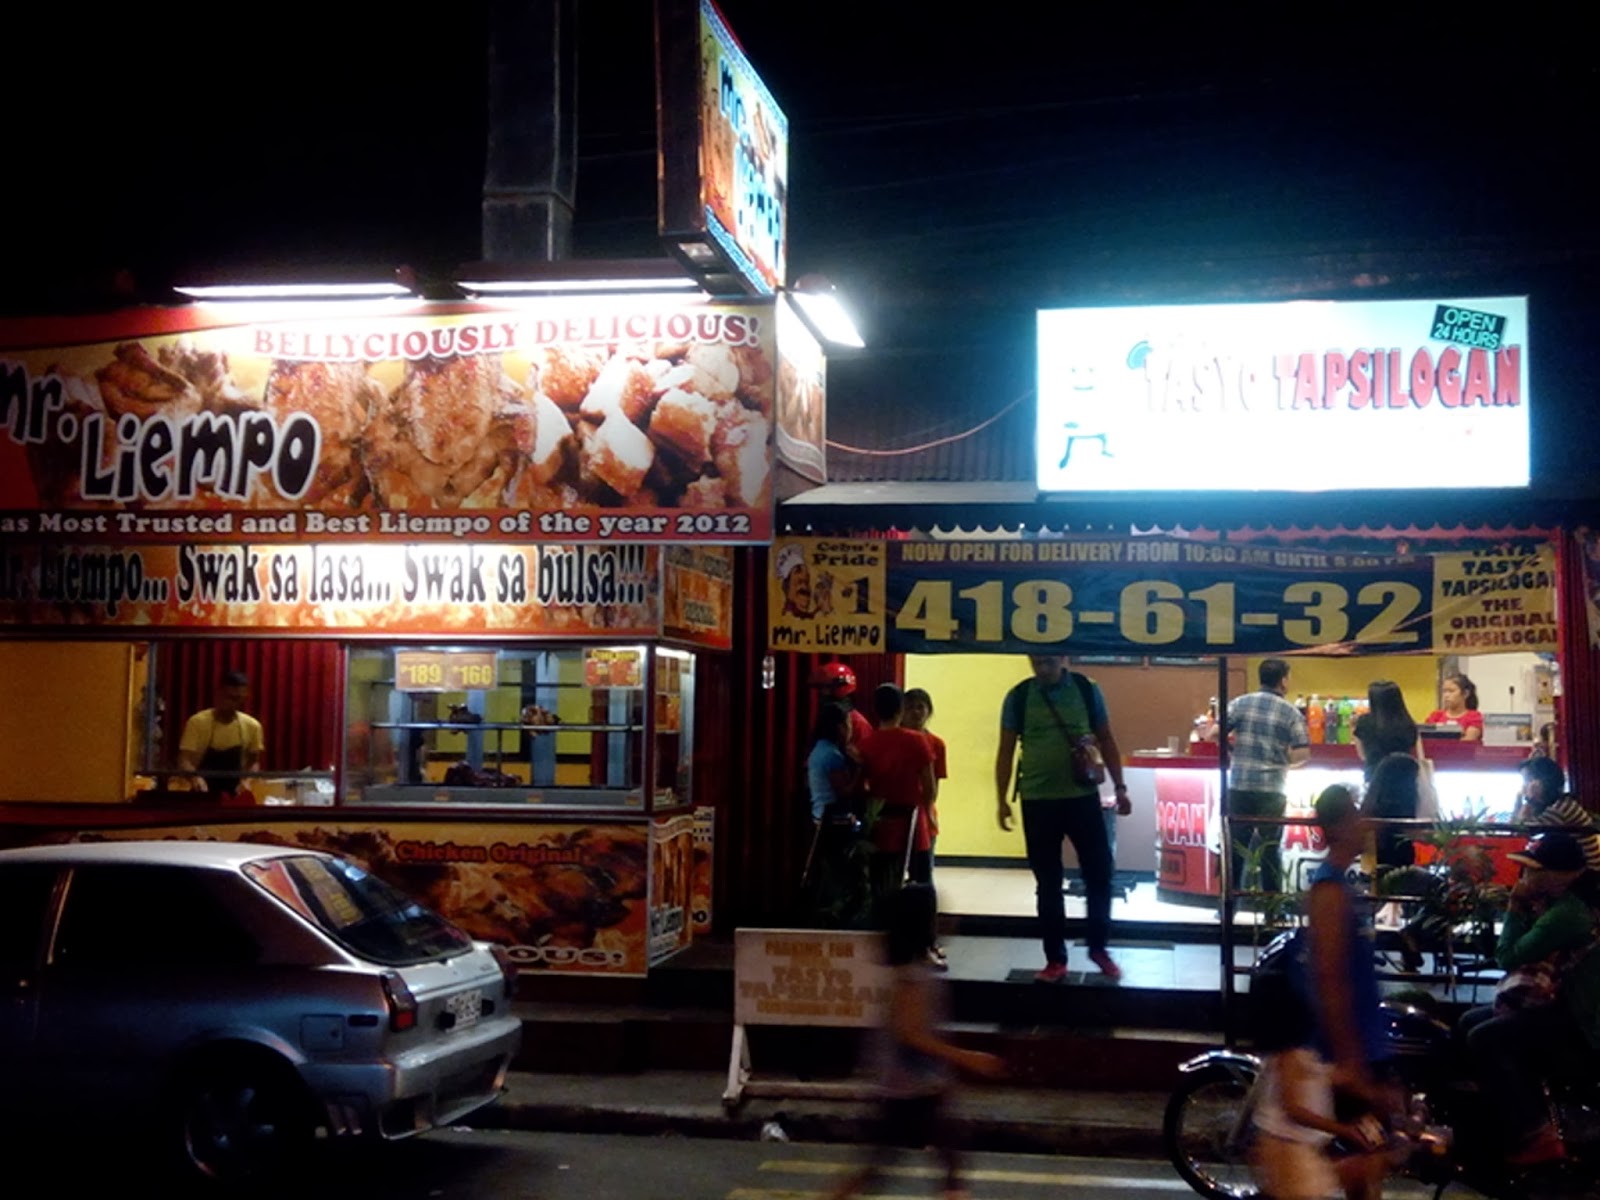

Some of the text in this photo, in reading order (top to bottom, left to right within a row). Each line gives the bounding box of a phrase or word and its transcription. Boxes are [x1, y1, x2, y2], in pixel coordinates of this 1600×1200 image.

[1443, 308, 1497, 332] OPEN
[254, 314, 759, 358] BELLYCIOUSLY DELICIOUS!
[1434, 323, 1500, 349] 24 HOURS
[1273, 344, 1521, 411] TAPSILOGAN
[39, 514, 107, 533] Most
[116, 514, 232, 533] Trusted
[241, 514, 296, 533] and
[305, 514, 371, 533] Best
[380, 514, 490, 537] Liempo
[500, 514, 531, 533] of
[540, 514, 590, 533] the
[599, 517, 666, 537] year
[677, 515, 750, 533] 2012
[812, 553, 880, 567] Pride
[903, 543, 945, 562] NOW
[950, 542, 995, 562] OPEN
[1001, 542, 1033, 562] FOR
[1039, 542, 1122, 562] DELIVERY
[1127, 541, 1178, 562] FROM
[1274, 551, 1328, 568] UNTIL
[177, 545, 260, 603] Swak
[270, 552, 298, 603] sa
[309, 545, 391, 603] lasa...
[402, 545, 486, 603] Swak
[497, 551, 526, 603] sa
[896, 579, 1421, 645] 418-61-32
[1482, 598, 1522, 612] THE
[1451, 612, 1556, 629] ORIGINAL
